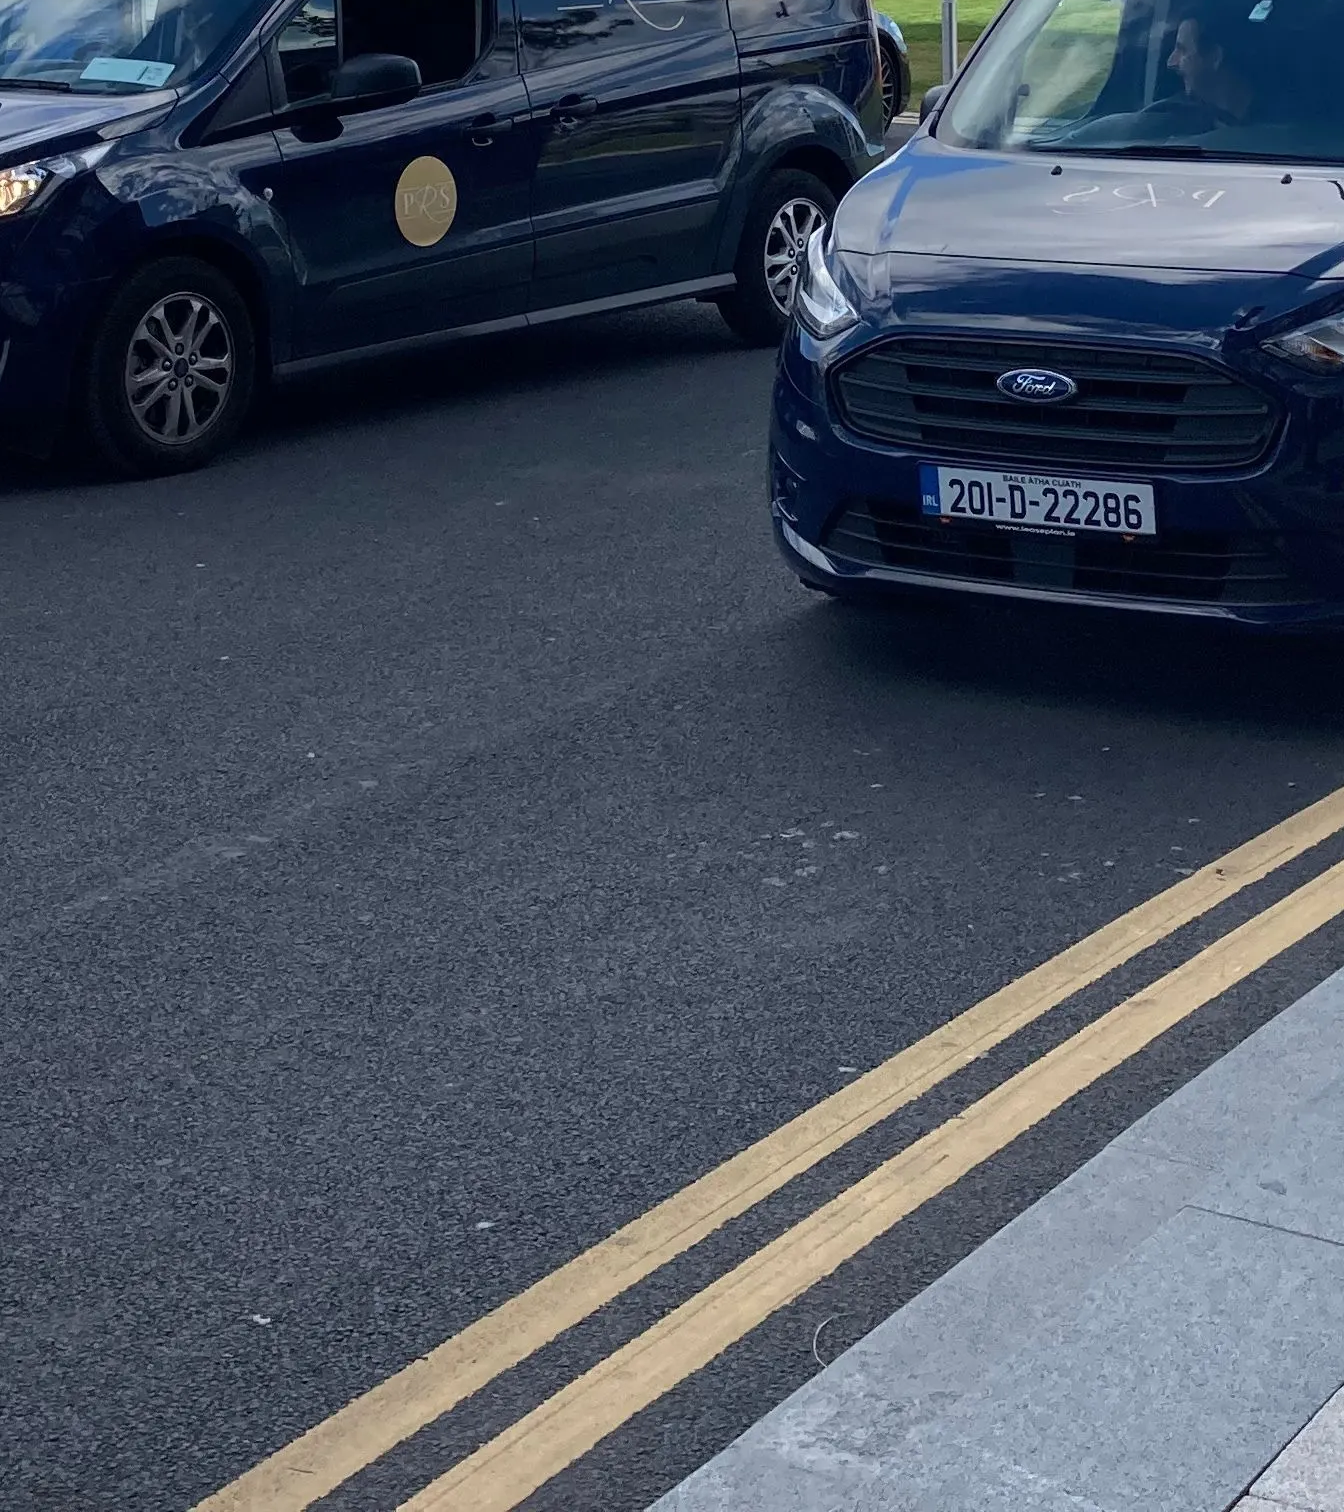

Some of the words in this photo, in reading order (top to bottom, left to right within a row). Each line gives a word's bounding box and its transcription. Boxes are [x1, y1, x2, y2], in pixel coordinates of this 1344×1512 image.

[1012, 372, 1056, 396] Ford
[922, 494, 939, 508] IRL
[948, 477, 1143, 531] 201-D-22286
